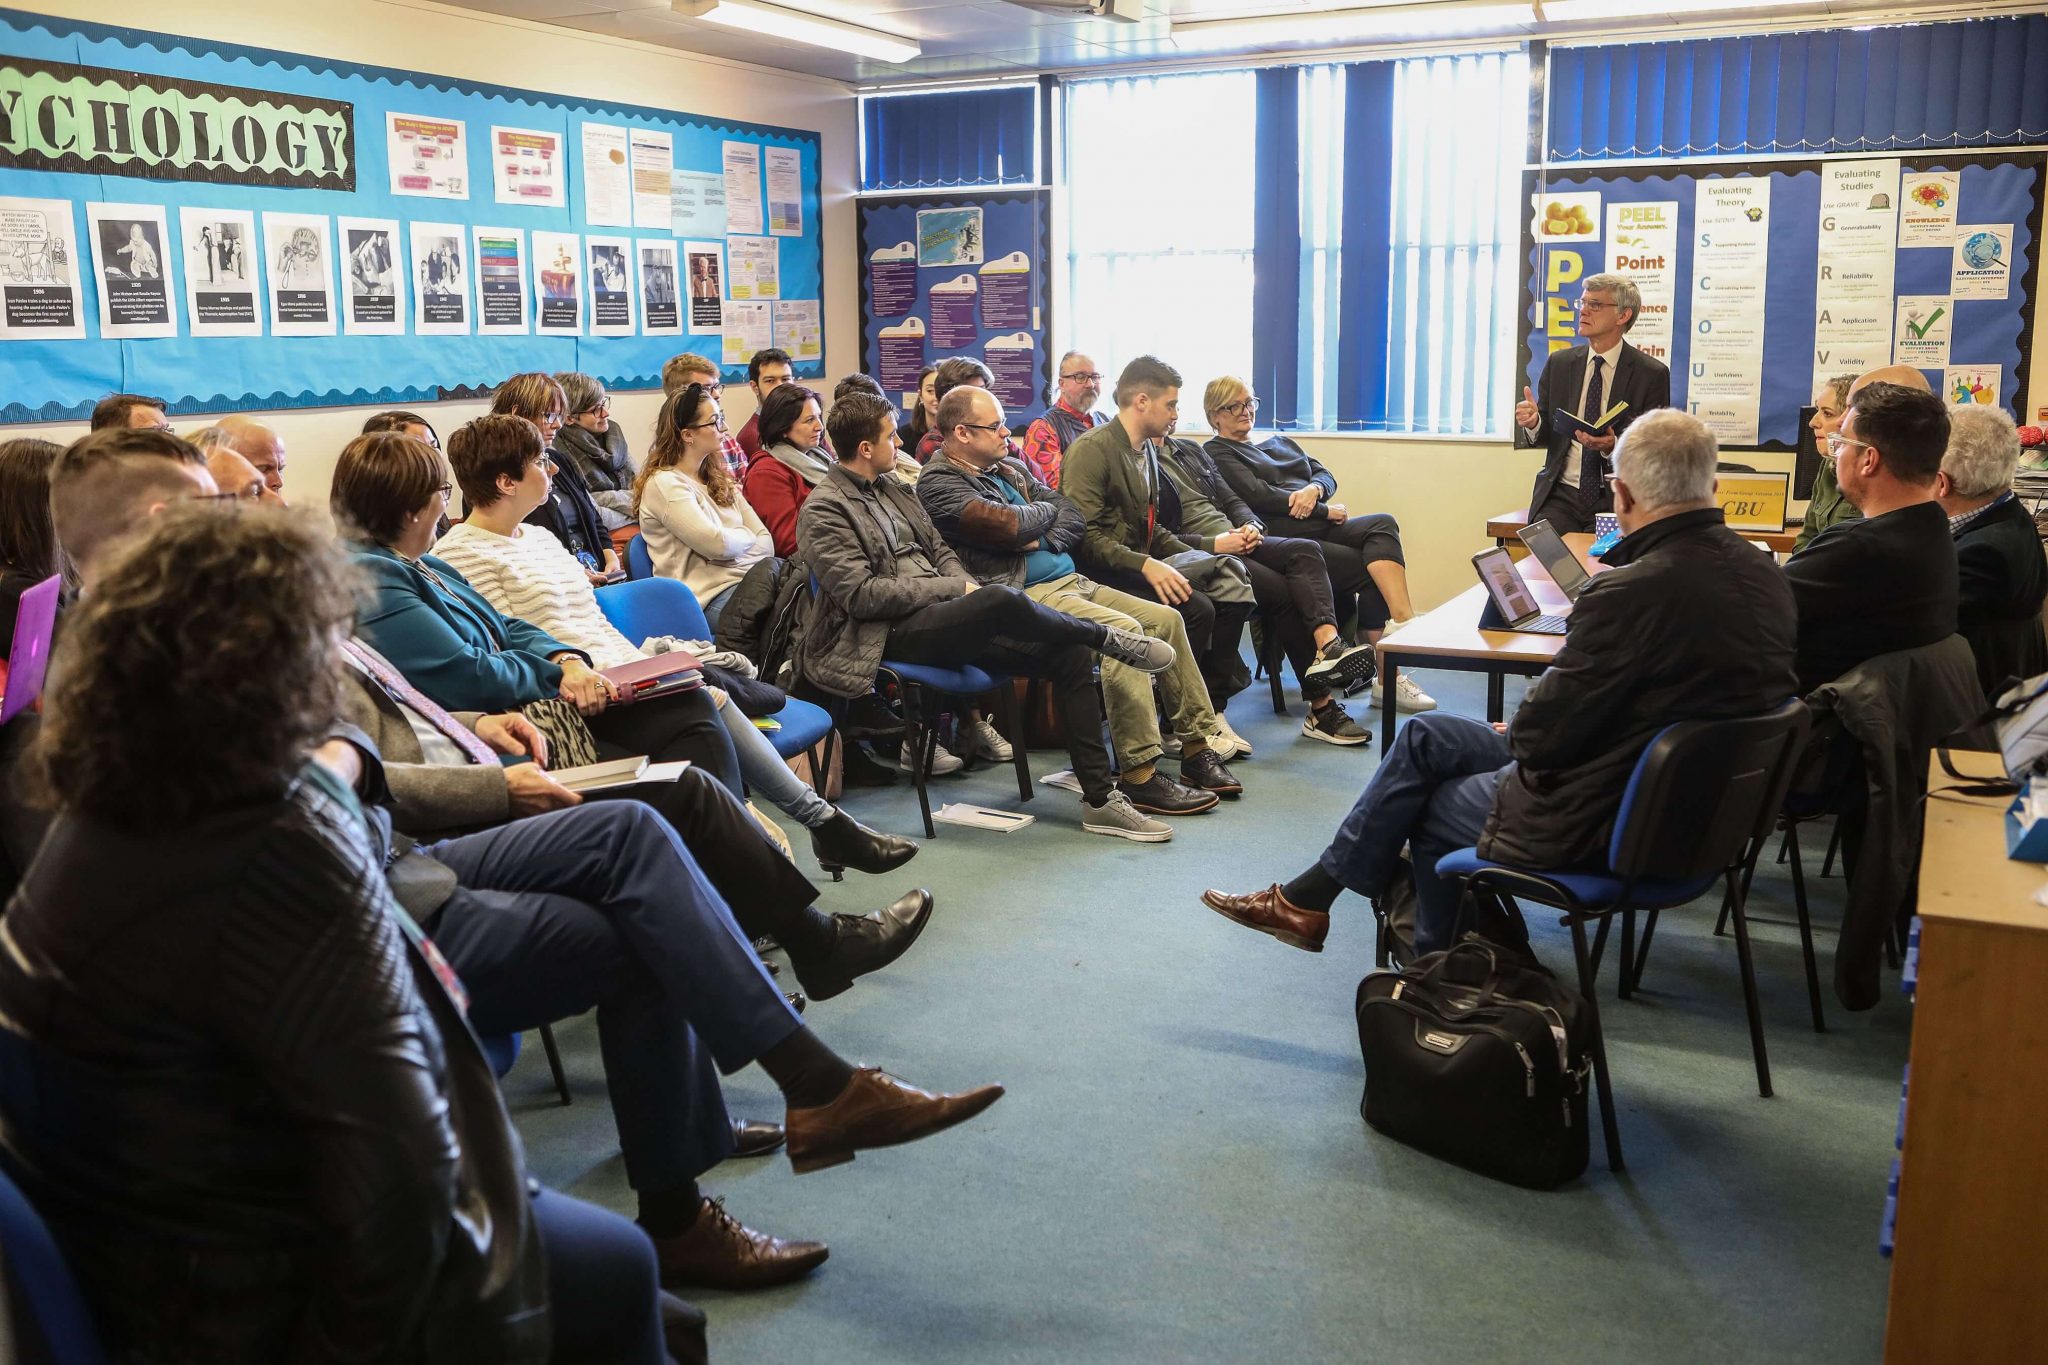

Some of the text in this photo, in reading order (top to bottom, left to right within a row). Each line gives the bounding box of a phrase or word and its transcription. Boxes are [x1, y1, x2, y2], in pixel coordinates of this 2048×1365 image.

[1834, 170, 1880, 179] Evaluating
[1708, 186, 1752, 195] Evaluating
[1840, 182, 1874, 191] Studies
[1620, 206, 1666, 222] PEEL
[1823, 217, 1836, 231] G
[1701, 234, 1711, 247] S
[1616, 255, 1665, 270] Point
[1821, 266, 1832, 280] R
[1700, 276, 1711, 290] C
[1640, 305, 1667, 313] ence
[1819, 310, 1832, 324] A
[1699, 320, 1712, 334] O
[1817, 351, 1830, 365] V
[1693, 363, 1704, 377] U
[1690, 402, 1700, 416] T
[1722, 500, 1765, 516] CBU
